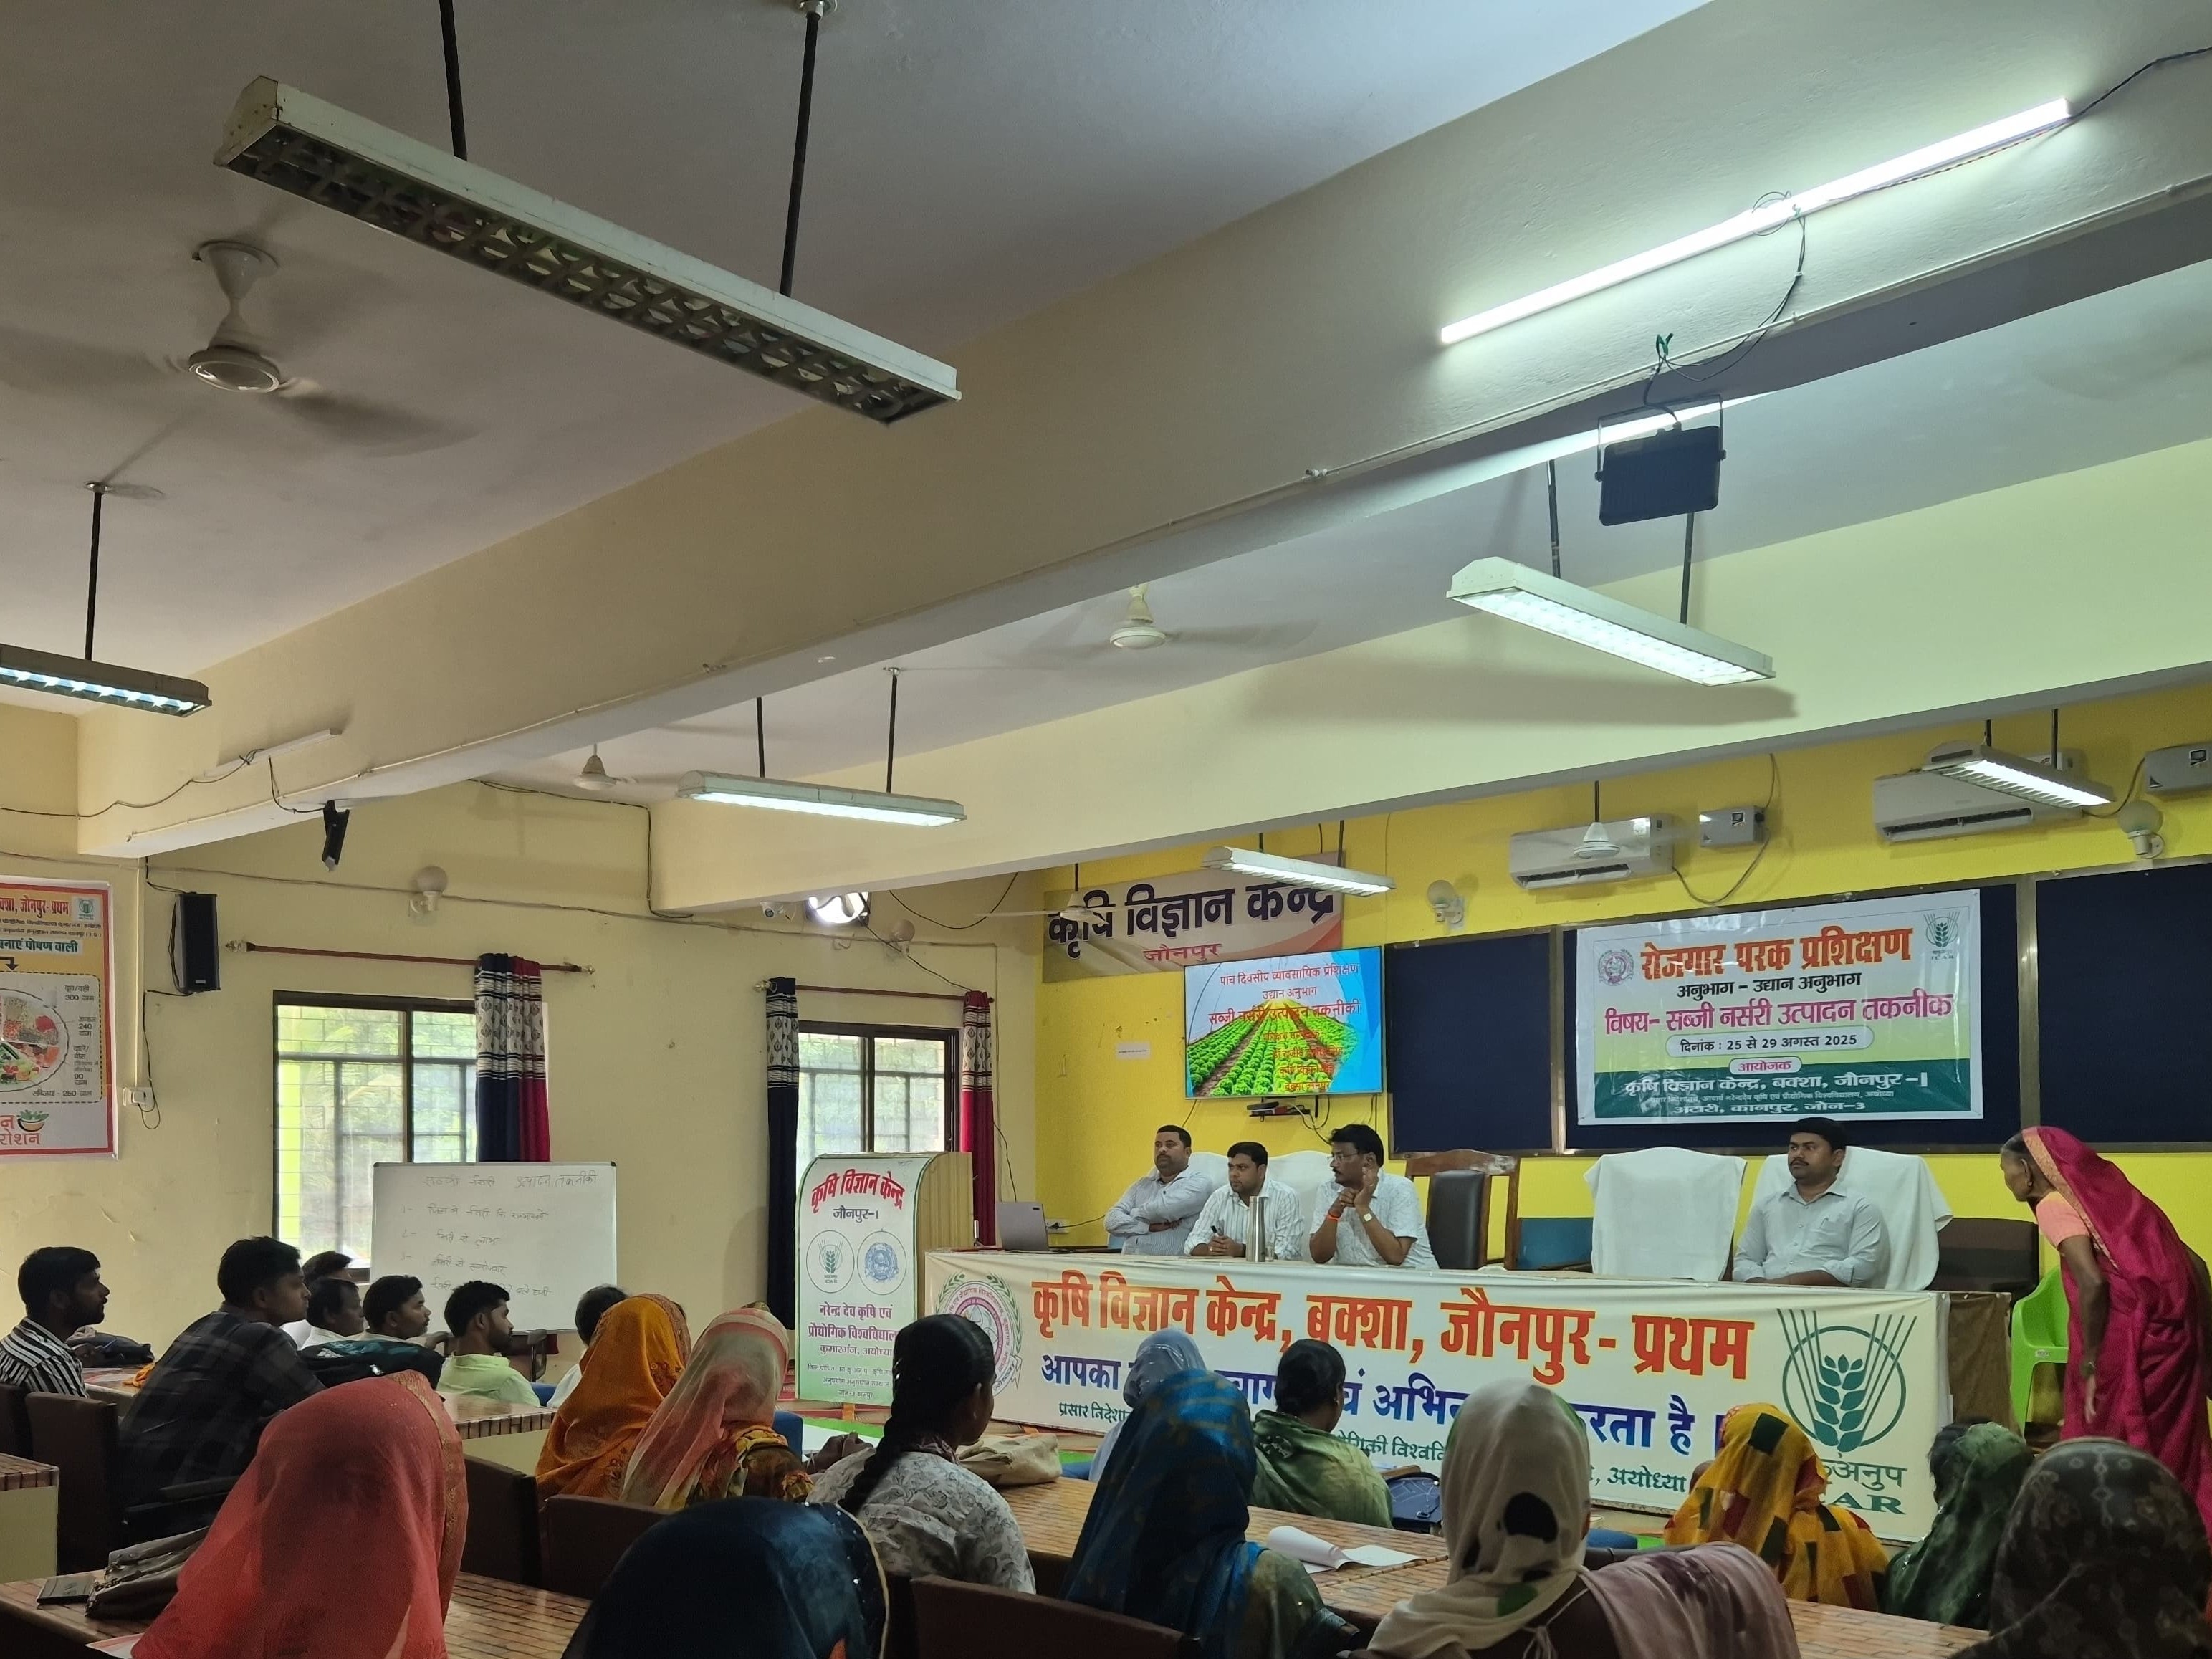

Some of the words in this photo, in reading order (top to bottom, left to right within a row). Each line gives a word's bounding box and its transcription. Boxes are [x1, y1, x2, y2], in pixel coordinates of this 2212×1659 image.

[1124, 884, 1235, 939] विज्ञान
[1143, 944, 1222, 967] जौनपुर
[1641, 942, 1726, 980] रोजगार
[1734, 939, 1794, 972] परक
[1800, 926, 1914, 970] प्रशिक्षण
[1263, 990, 1284, 1000] उद्यान
[1288, 986, 1317, 999] अनुभाग
[1677, 982, 1735, 1001] अनुभाग
[1753, 977, 1794, 993] उद्यान
[1798, 972, 1862, 993] अनुभाग
[1208, 1008, 1235, 1025] सब्जी
[1666, 1001, 1714, 1031] सब्जी
[1720, 997, 1773, 1028] नर्सरी
[1778, 999, 1857, 1025] उत्पादन
[1862, 987, 1953, 1020] तकनीक
[1680, 1038, 1715, 1053] दिनांक
[1726, 1040, 1741, 1050] 25
[1746, 1036, 1757, 1049] से
[1762, 1038, 1776, 1048] 29
[1781, 1036, 1819, 1048] अगस्त
[1824, 1034, 1857, 1046] 2025
[1738, 1060, 1792, 1071] आयोजक
[1624, 1079, 1660, 1096] कृषि
[1662, 1078, 1715, 1093] विज्ञान
[1720, 1076, 1766, 1091] केन्द्र,
[1753, 1092, 1768, 1102] कृषि
[1730, 1103, 1799, 1114] कानपुर,
[811, 1172, 840, 1213] कृषि
[840, 1168, 880, 1195] विज्ञान
[880, 1170, 905, 1210] केन्द्र
[820, 1301, 841, 1316] नरेन्द्र
[843, 1302, 856, 1317] देव
[858, 1304, 876, 1321] कृषि
[879, 1304, 894, 1319] एवं
[808, 1322, 846, 1338] प्रौद्योगिक
[848, 1325, 898, 1341] विश्वविद्याल
[1032, 1270, 1093, 1338] कृषि
[1100, 1271, 1199, 1334] विज्ञान
[1206, 1275, 1292, 1352] केन्द्र,
[1306, 1295, 1424, 1364] बक्शा,
[1632, 1314, 1756, 1380] प्रथम
[820, 1344, 860, 1355] कुमारगंज,
[863, 1346, 892, 1356] अयोध्या
[1041, 1354, 1121, 1390] आपका
[1569, 1402, 1656, 1448] रता
[1667, 1394, 1695, 1455] है
[1059, 1402, 1089, 1418] प्रसार
[1607, 1465, 1687, 1493] अयोध्या
